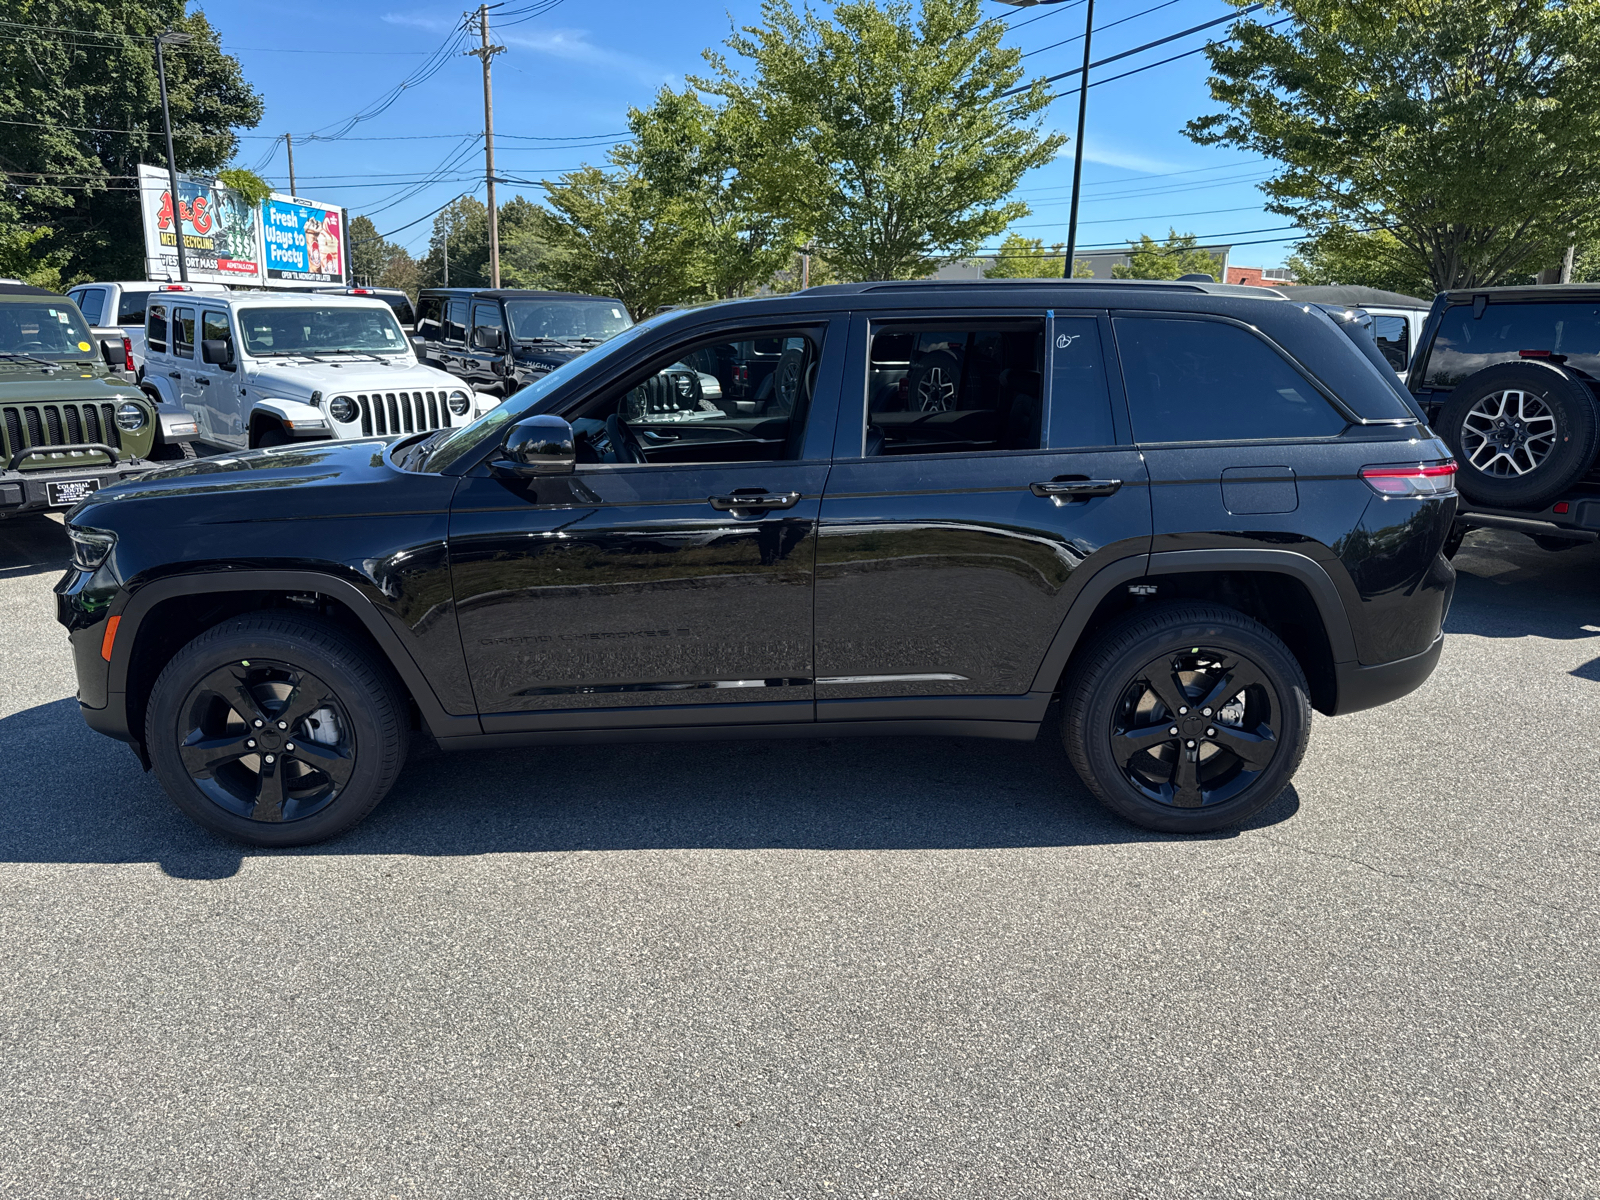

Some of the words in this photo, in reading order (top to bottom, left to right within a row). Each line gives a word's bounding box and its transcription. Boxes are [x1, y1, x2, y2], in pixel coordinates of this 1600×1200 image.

[157, 190, 212, 235] A&E
[269, 207, 298, 228] Fresh
[161, 232, 178, 247] META
[182, 235, 214, 250] RECYCLING
[265, 225, 293, 249] Ways
[293, 231, 305, 246] to
[160, 254, 199, 268] WESTORT
[200, 258, 218, 270] MASS
[270, 244, 303, 268] Frosty
[226, 262, 255, 271] AEMETALS.COM
[281, 271, 292, 279] OPEN
[321, 274, 331, 282] LATER
[526, 360, 547, 370] HIGH
[57, 482, 90, 490] COLONIAL
[479, 636, 552, 646] GRAND
[558, 629, 670, 642] CHEROKEE
